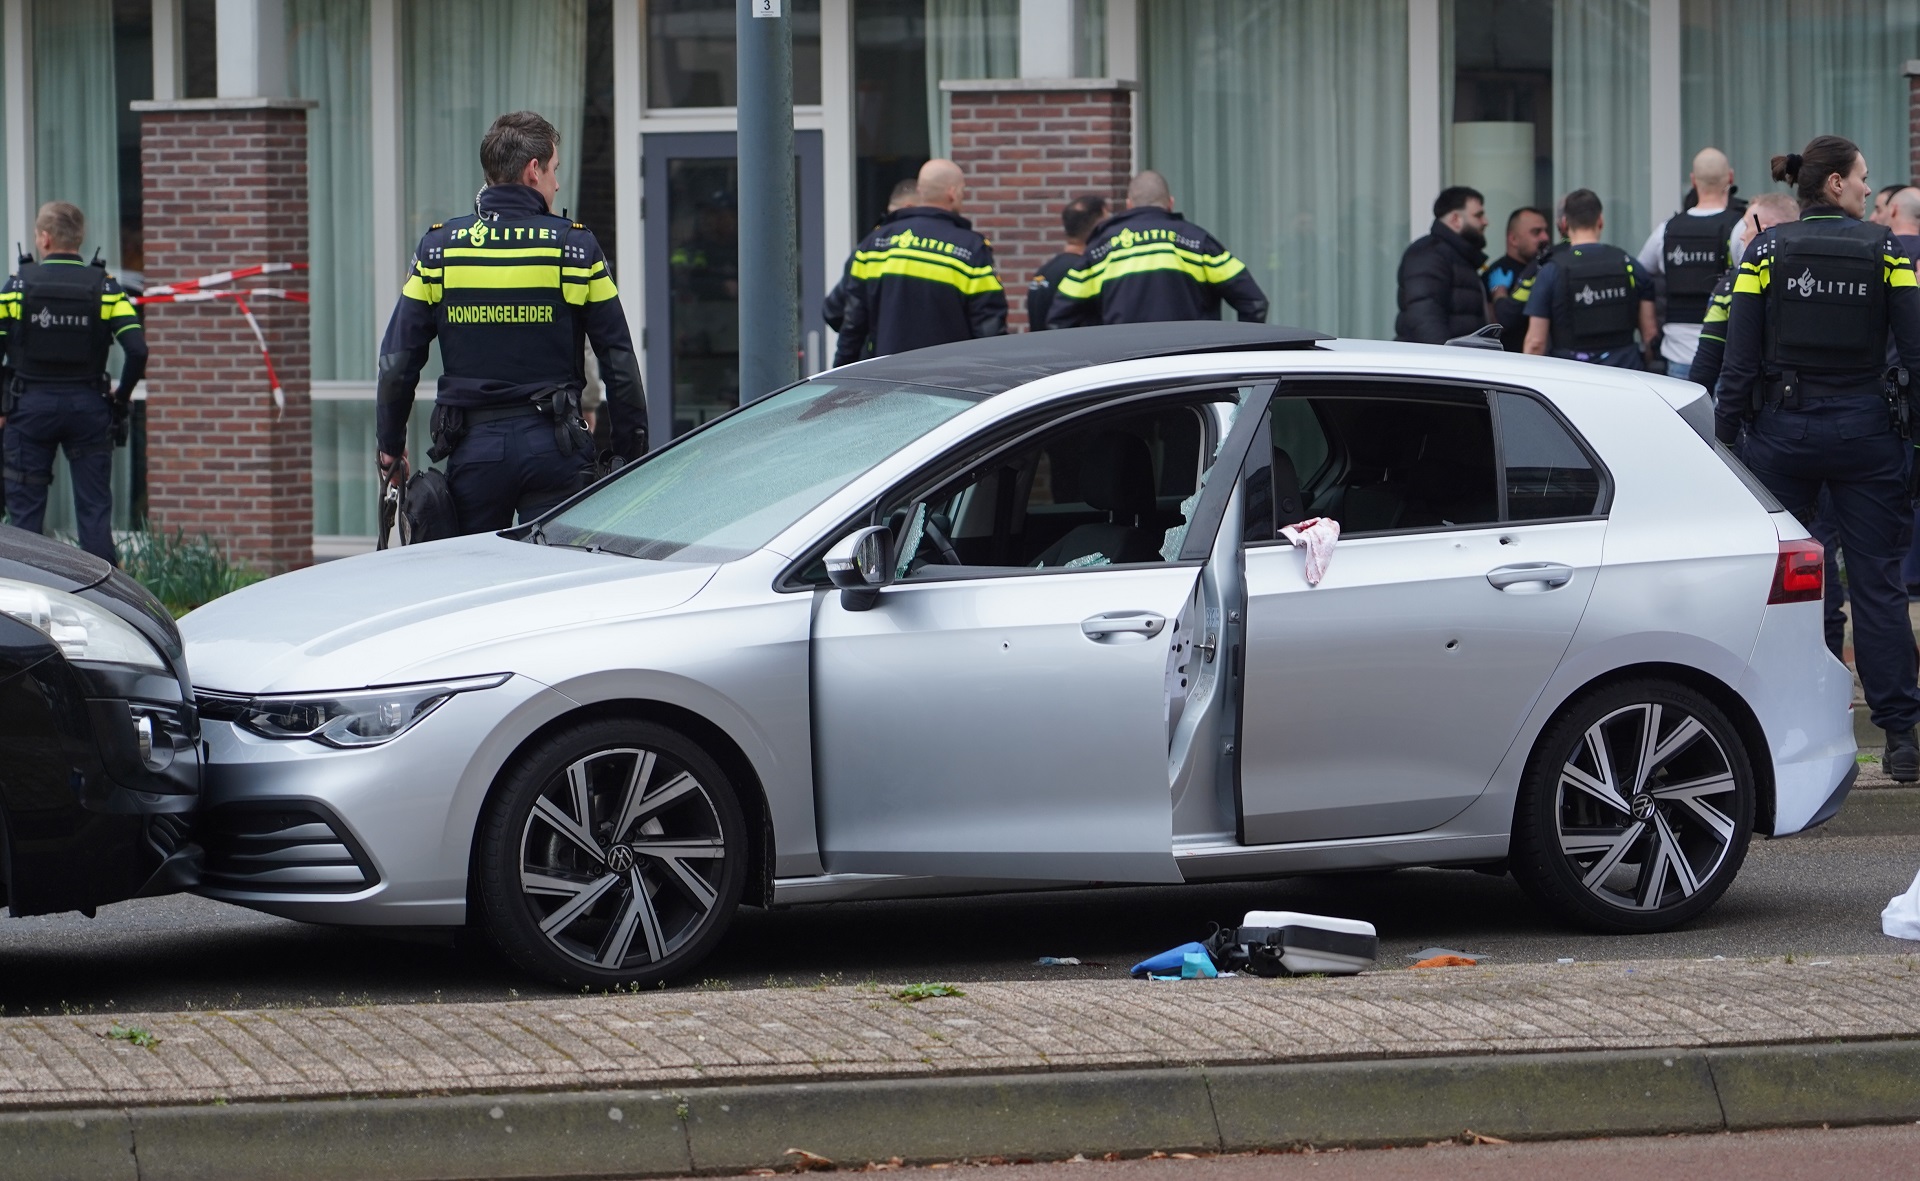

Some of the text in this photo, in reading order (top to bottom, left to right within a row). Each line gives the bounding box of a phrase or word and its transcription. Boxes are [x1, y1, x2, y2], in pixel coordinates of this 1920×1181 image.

[763, 0, 771, 10] 3
[457, 219, 550, 247] POLITIE
[890, 228, 955, 254] POLITIE
[1110, 227, 1177, 249] POLITIE
[1666, 244, 1716, 266] POLITIE
[1787, 267, 1868, 298] POLITIE
[1574, 284, 1627, 305] POLITIE
[31, 305, 89, 329] POLITIE
[447, 305, 553, 323] HONDENGELEIDER
